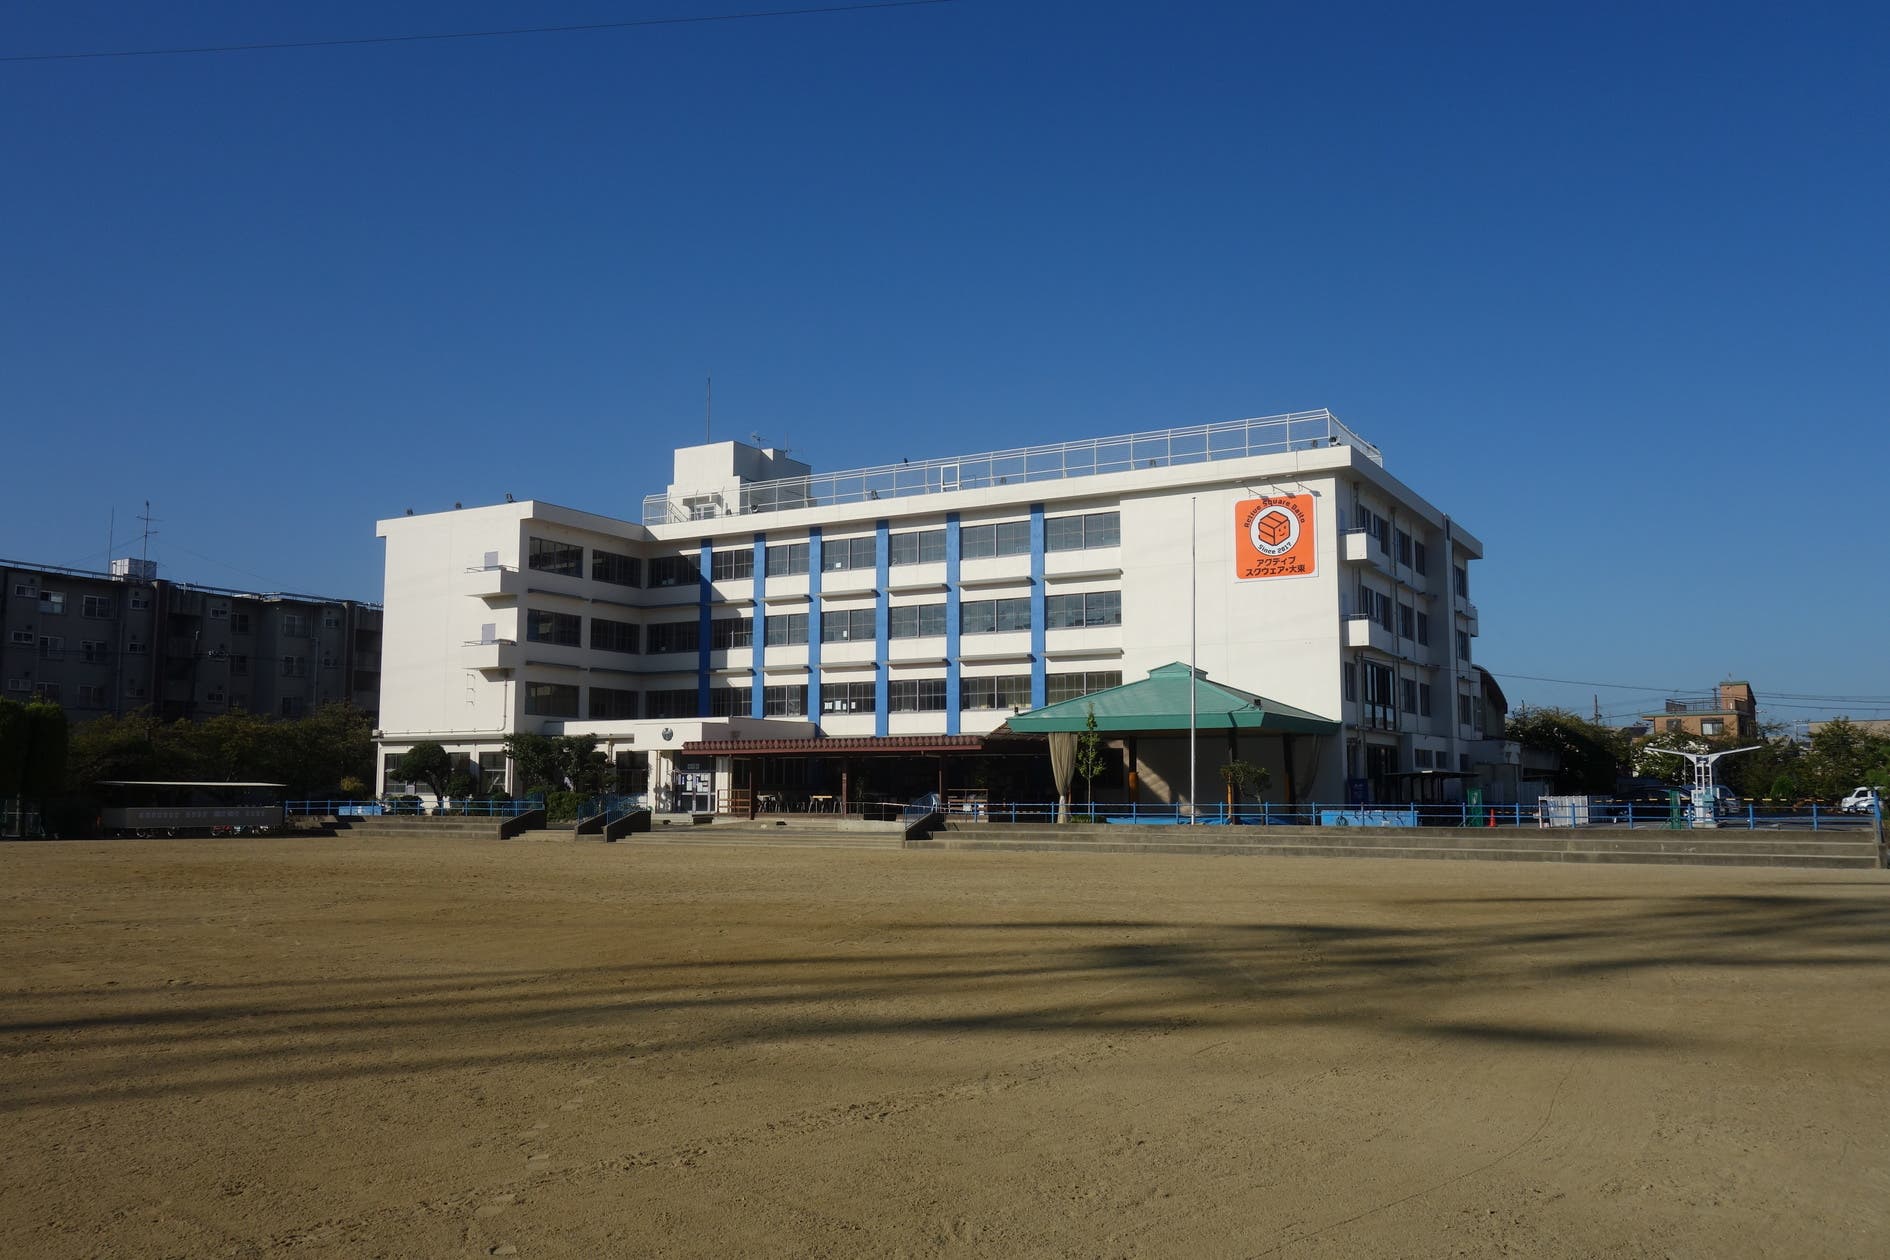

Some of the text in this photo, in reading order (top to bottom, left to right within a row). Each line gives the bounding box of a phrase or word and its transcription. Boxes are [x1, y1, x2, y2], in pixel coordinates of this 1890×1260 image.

[1244, 499, 1305, 527] Active Square Daito
[1258, 541, 1292, 554] Since 2017
[1256, 556, 1296, 567] アクティブ
